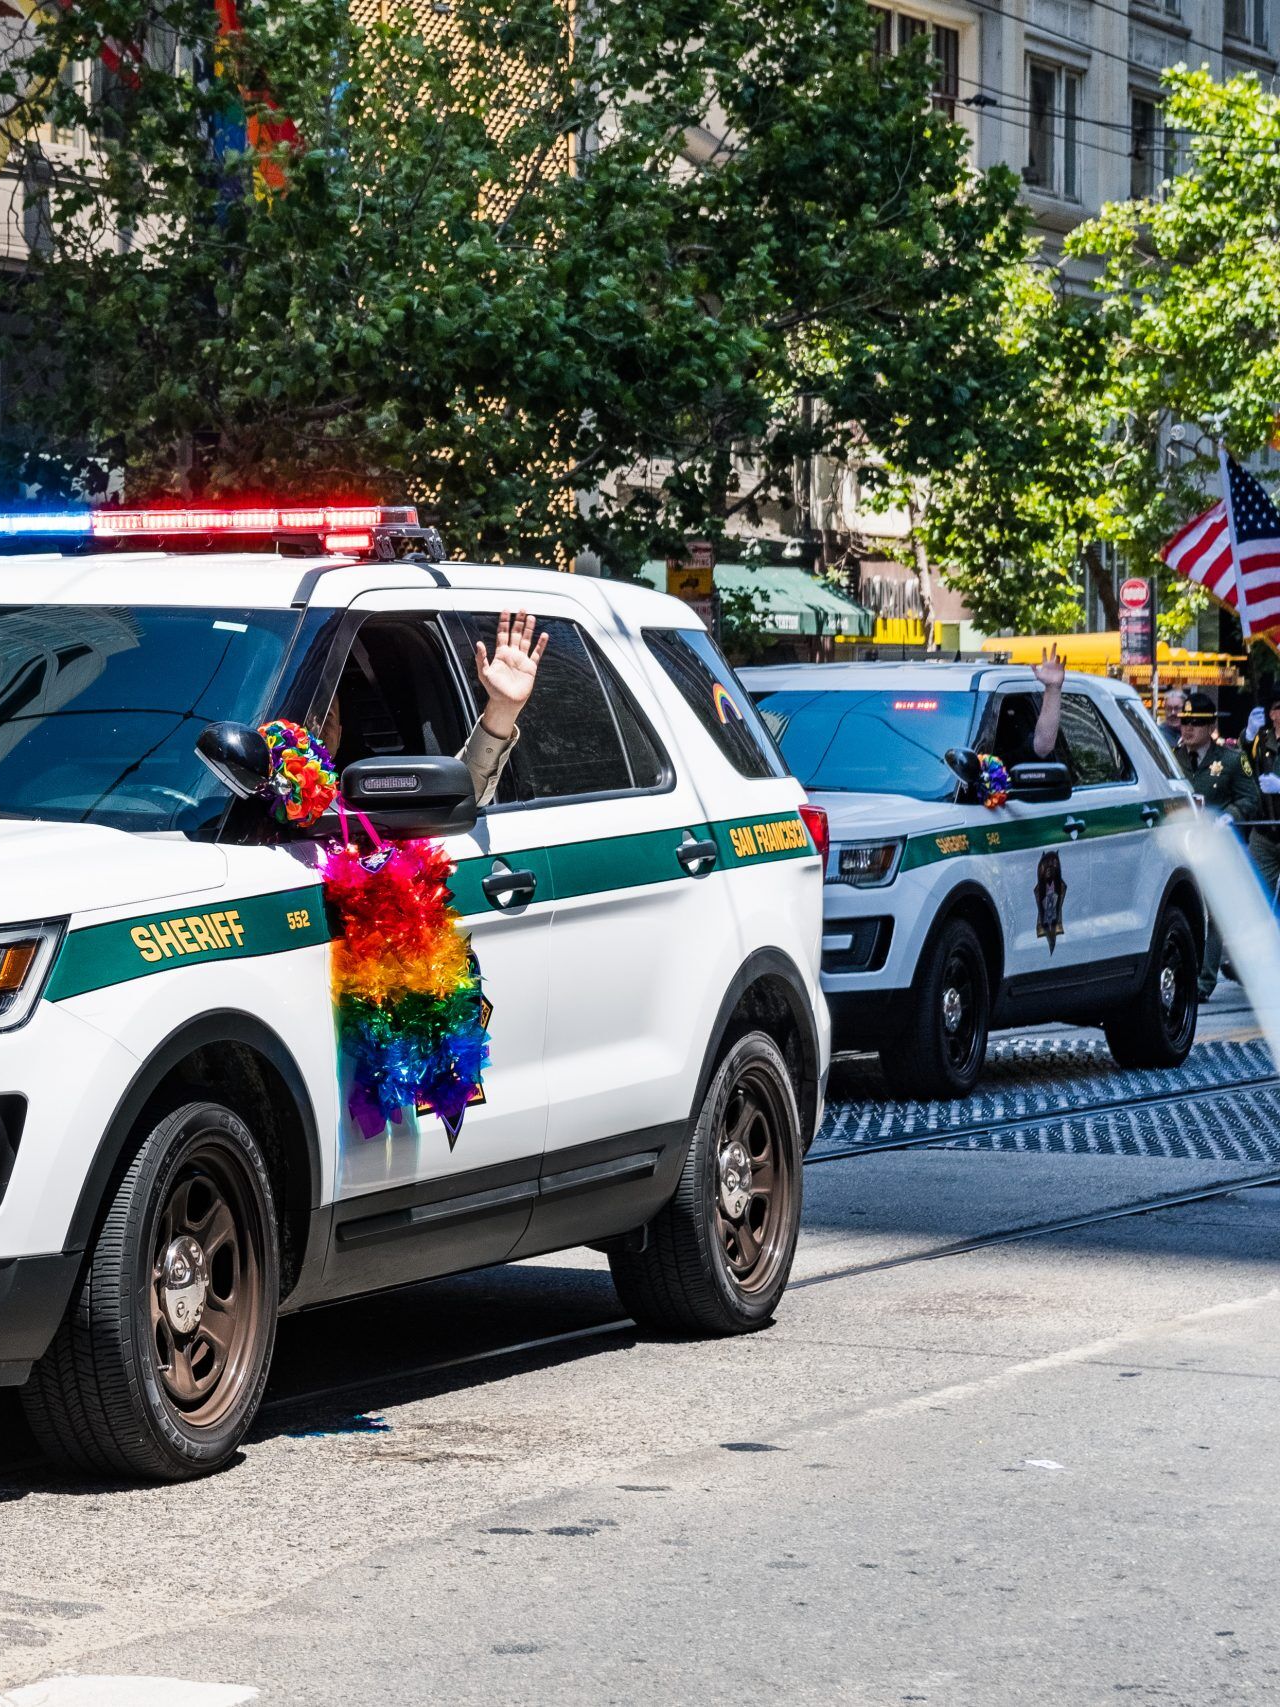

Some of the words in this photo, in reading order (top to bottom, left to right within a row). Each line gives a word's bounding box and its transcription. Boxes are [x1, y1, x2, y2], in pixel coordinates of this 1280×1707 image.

[729, 826, 758, 858] SAN
[753, 819, 808, 854] FRANCISCO
[935, 834, 970, 854] SHERIFF
[985, 832, 1001, 846] 542
[286, 909, 311, 930] 552
[130, 910, 245, 962] SHERIFF
